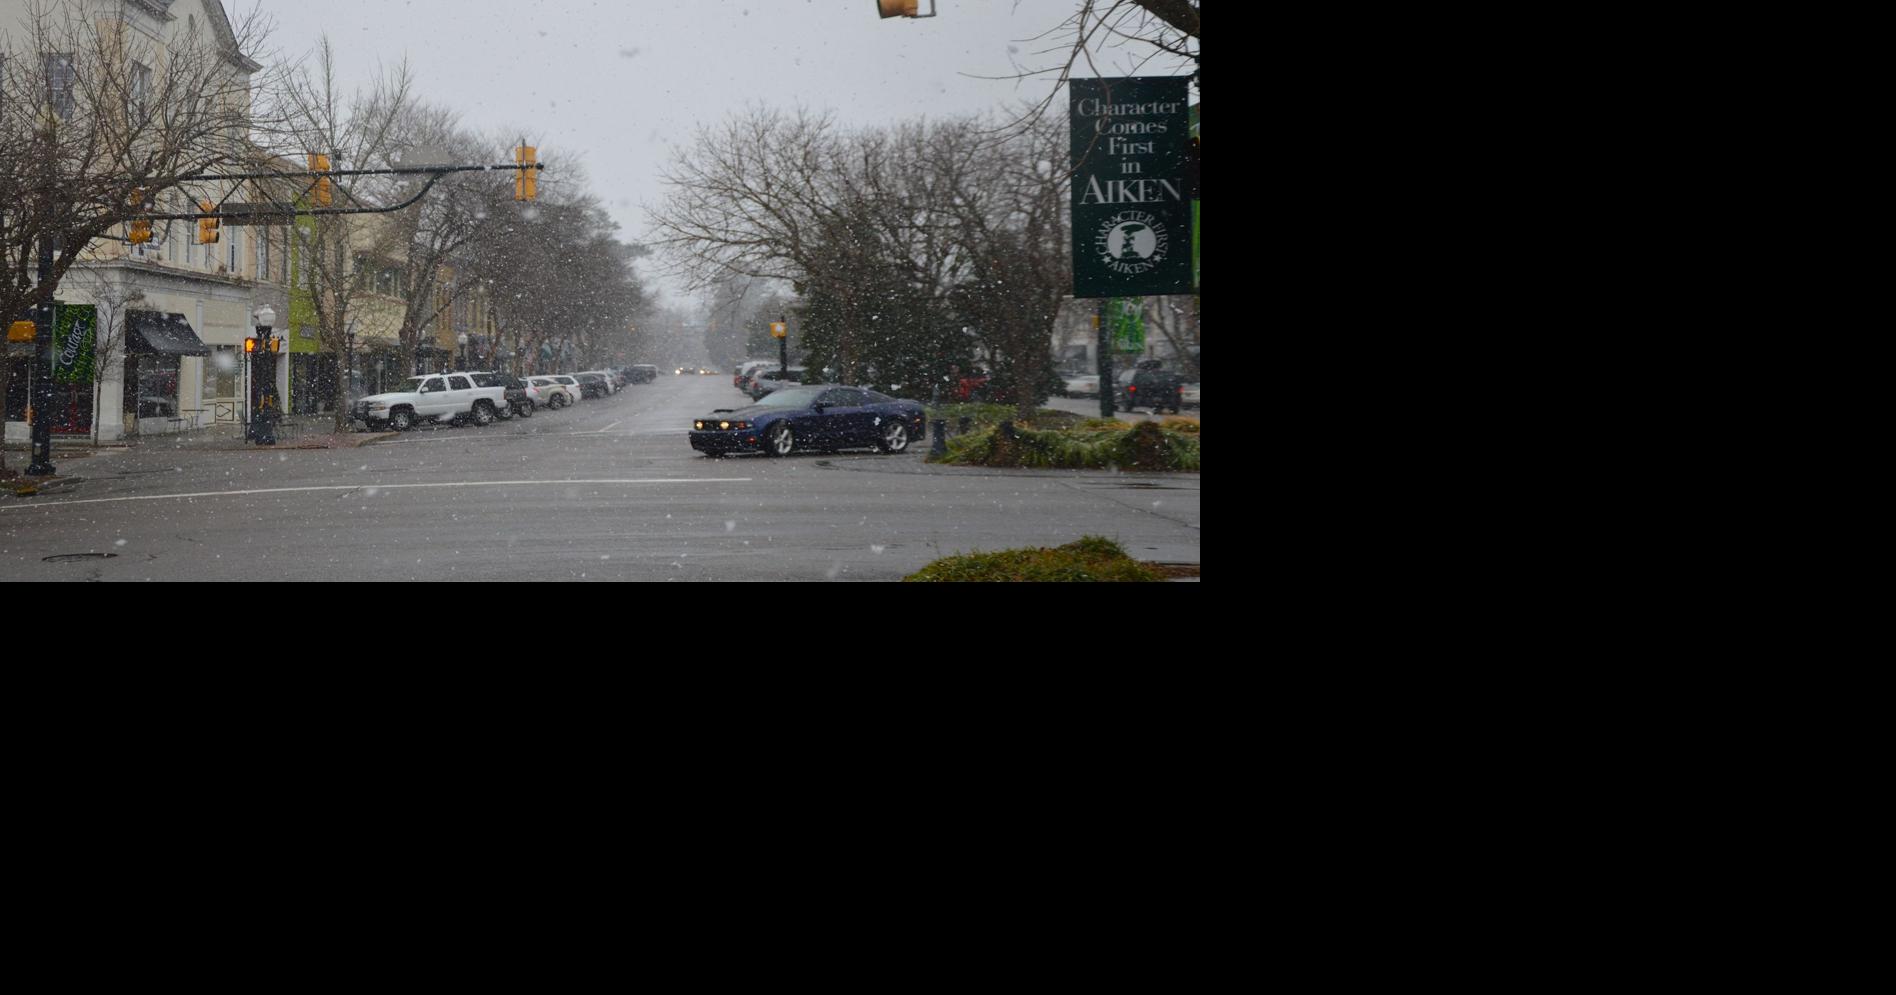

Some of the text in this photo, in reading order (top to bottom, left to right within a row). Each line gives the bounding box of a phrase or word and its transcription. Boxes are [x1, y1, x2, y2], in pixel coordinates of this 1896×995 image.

[1078, 98, 1181, 116] Character
[1095, 119, 1168, 135] Comes
[1108, 136, 1154, 155] First
[1120, 157, 1142, 174] in
[1079, 174, 1183, 205] AIKEN
[1095, 210, 1168, 257] CHARACTER FIRST
[1108, 260, 1154, 274] AIKEN
